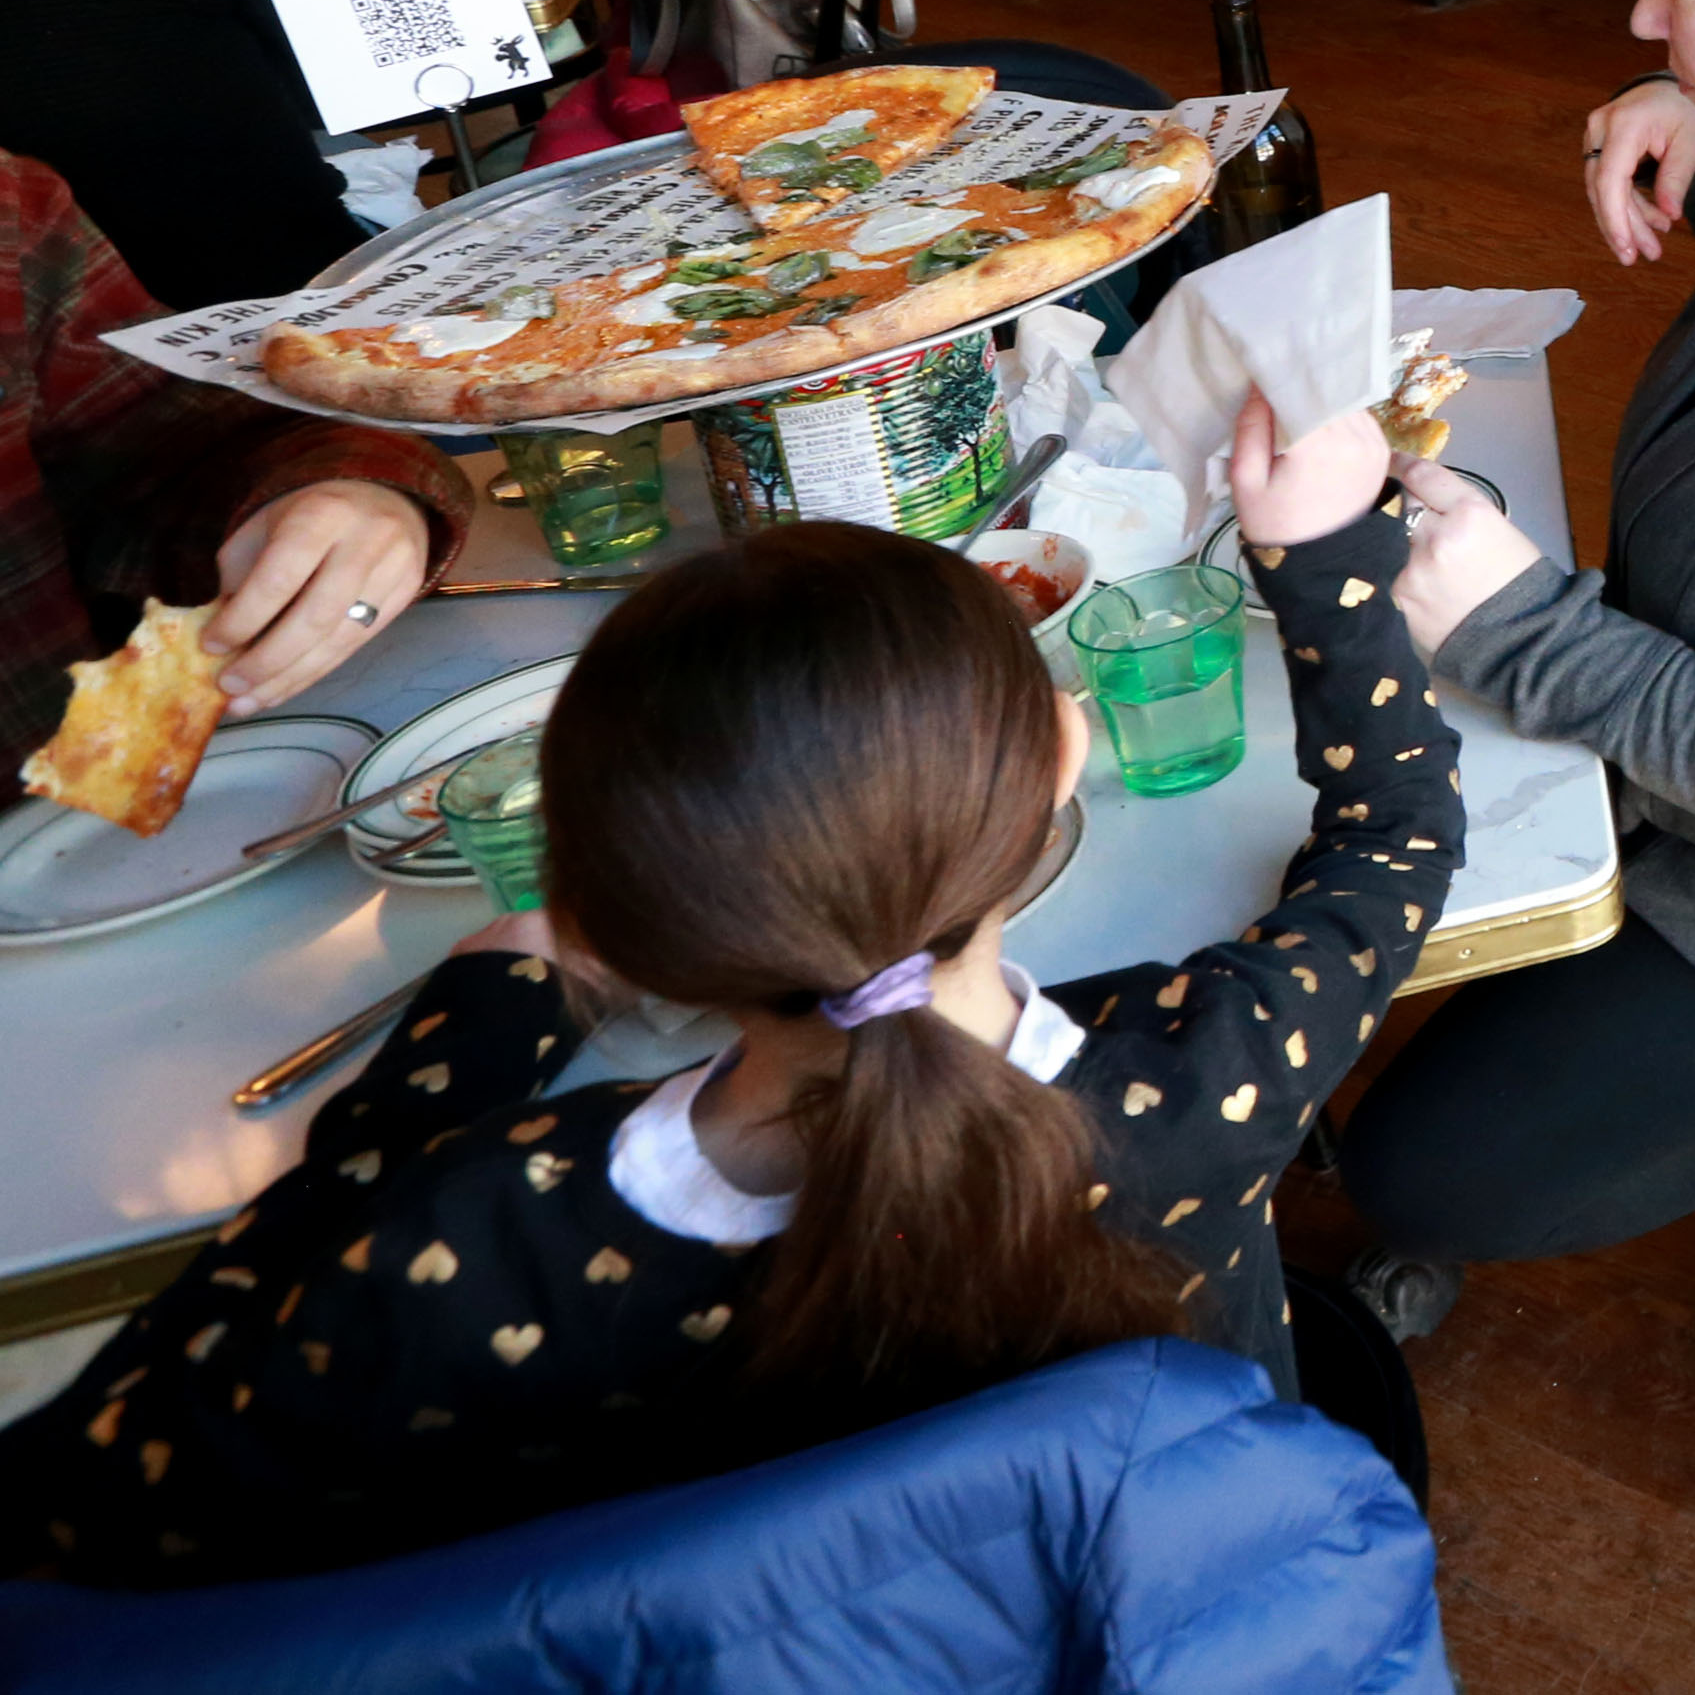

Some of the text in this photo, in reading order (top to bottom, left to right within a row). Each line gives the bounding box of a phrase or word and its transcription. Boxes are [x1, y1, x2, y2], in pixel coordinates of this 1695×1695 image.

[376, 291, 441, 318] PIES
[154, 303, 276, 348] THE KIN
